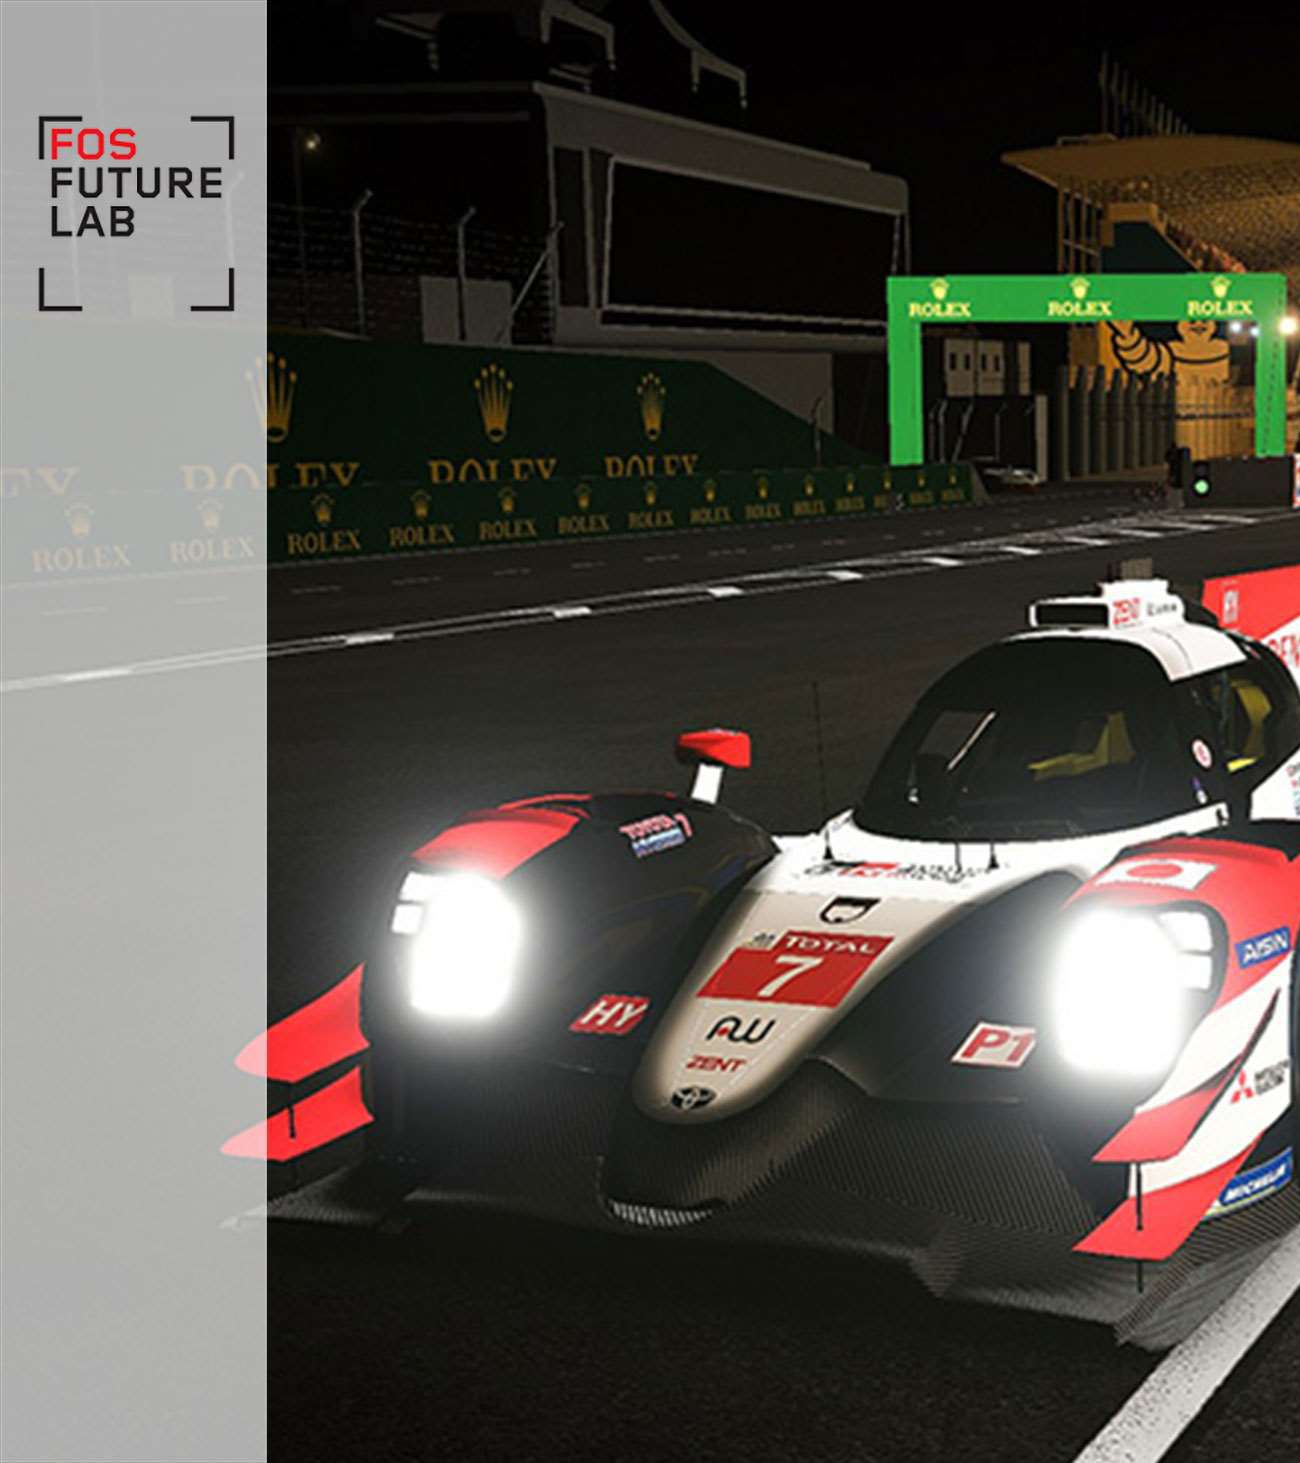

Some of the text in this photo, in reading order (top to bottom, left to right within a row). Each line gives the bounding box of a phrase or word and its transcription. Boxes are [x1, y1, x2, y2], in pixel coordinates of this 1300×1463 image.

[909, 301, 971, 317] ROLEX
[1048, 301, 1112, 316] ROLEX
[1187, 300, 1252, 316] ROLEX
[480, 518, 538, 541] ROLEX
[558, 513, 610, 534] ROLEX
[628, 509, 674, 529] ROLEX
[288, 528, 361, 555] ROLEX
[390, 523, 455, 548] ROLEX
[32, 545, 131, 573] ROLEX
[170, 536, 255, 563] ROLEX
[784, 936, 878, 955] TOTAL
[1240, 928, 1289, 965] AISIN
[757, 956, 822, 998] 7
[580, 998, 646, 1029] HY
[960, 1028, 1036, 1061] P1
[686, 1054, 747, 1073] ZENT
